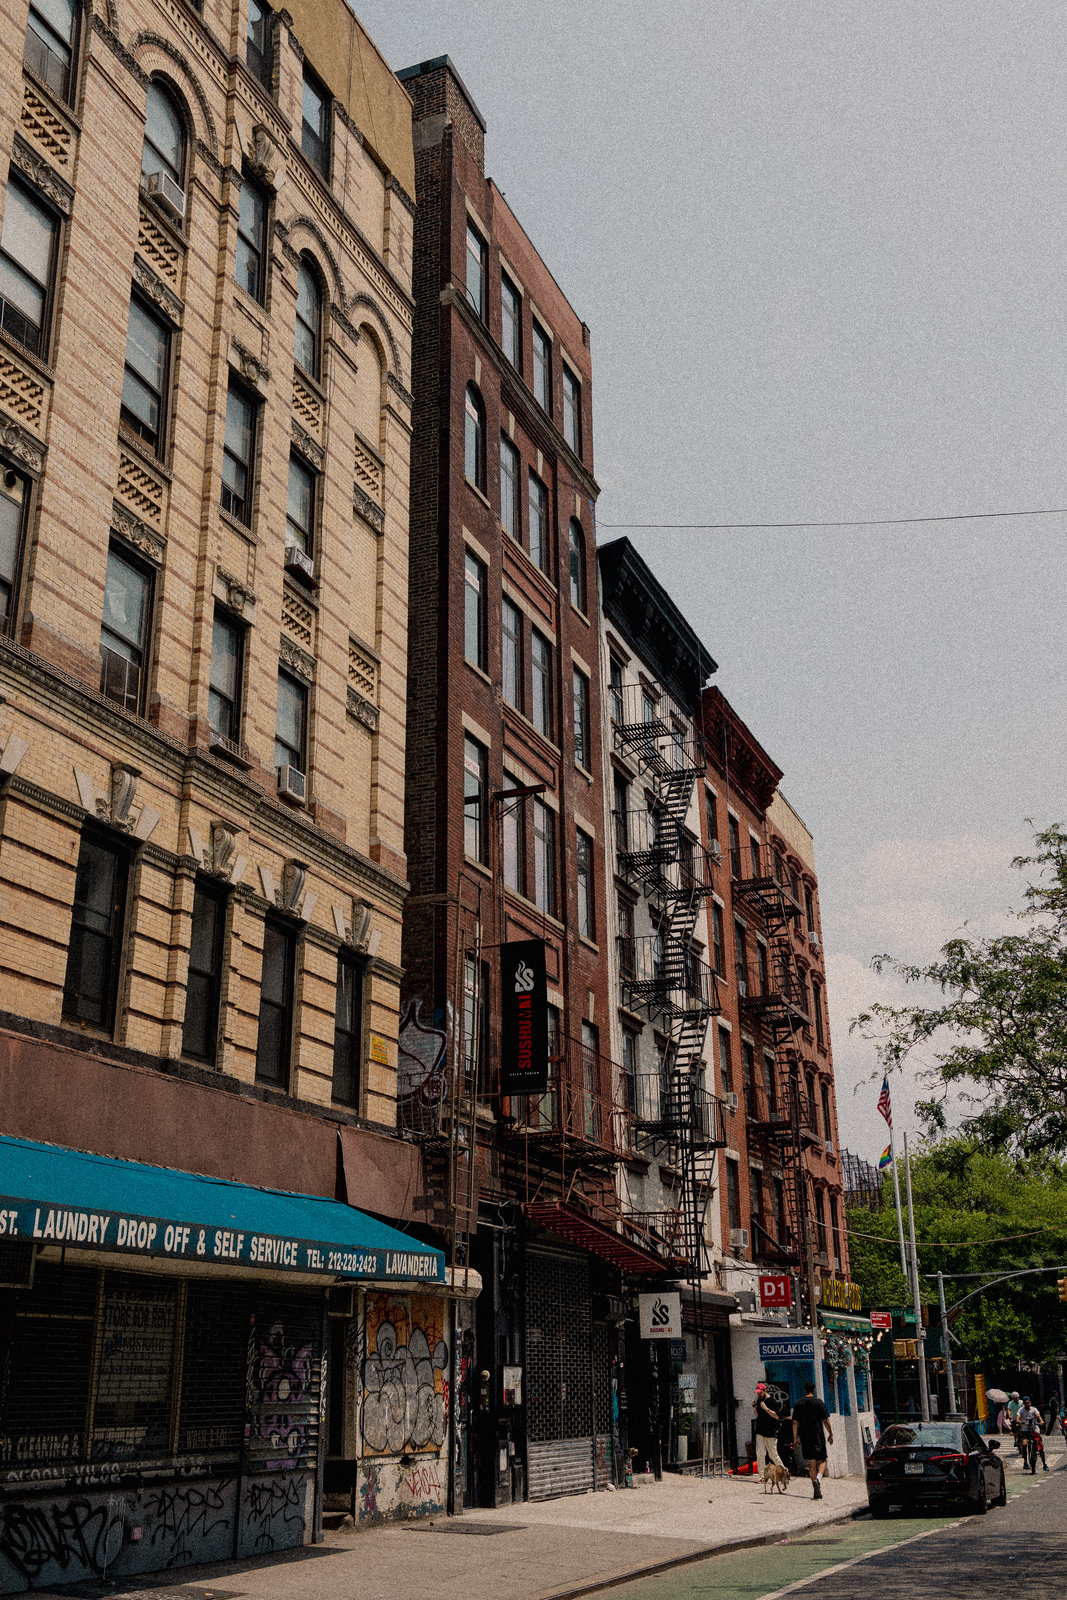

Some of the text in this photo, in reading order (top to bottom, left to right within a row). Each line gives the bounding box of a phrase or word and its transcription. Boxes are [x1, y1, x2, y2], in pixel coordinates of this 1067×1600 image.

[33, 1208, 110, 1244] LAUNDRY
[117, 1218, 157, 1249] DROP
[164, 1225, 190, 1253] OFF
[197, 1229, 206, 1255] &
[214, 1230, 244, 1258] SELF
[250, 1236, 298, 1266] SERVICE
[307, 1249, 324, 1269] TEL:
[328, 1251, 376, 1273] 212-228-2423
[385, 1253, 438, 1277] LAVANDERIA
[763, 1281, 785, 1297] D1
[762, 1343, 801, 1354] SOUVLAKI
